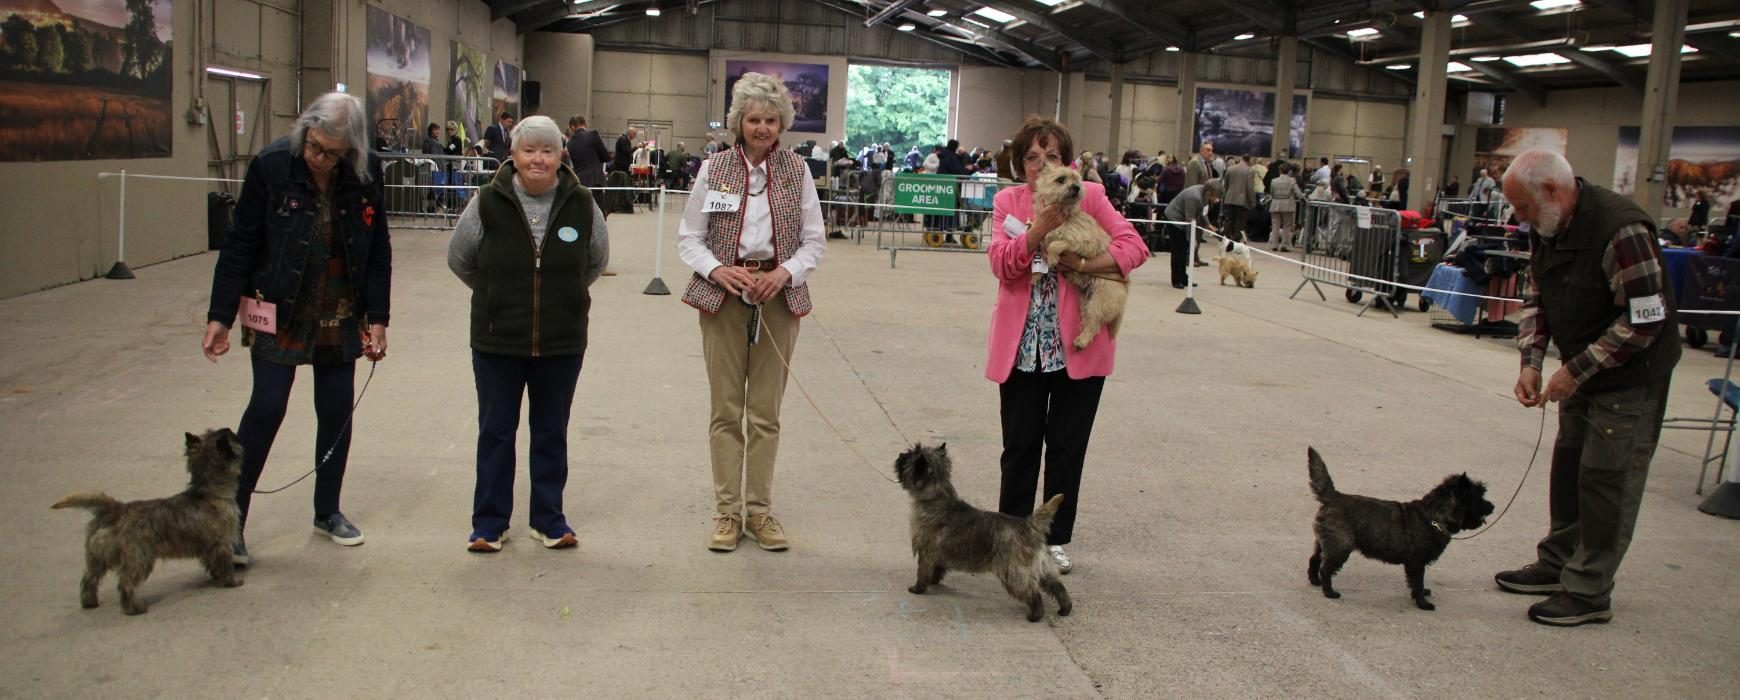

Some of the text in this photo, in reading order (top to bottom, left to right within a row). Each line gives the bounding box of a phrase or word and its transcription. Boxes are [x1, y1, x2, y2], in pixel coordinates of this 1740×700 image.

[898, 183, 954, 195] GROOMING
[911, 194, 939, 205] AREA
[710, 201, 733, 211] 1087
[248, 313, 269, 326] 1075
